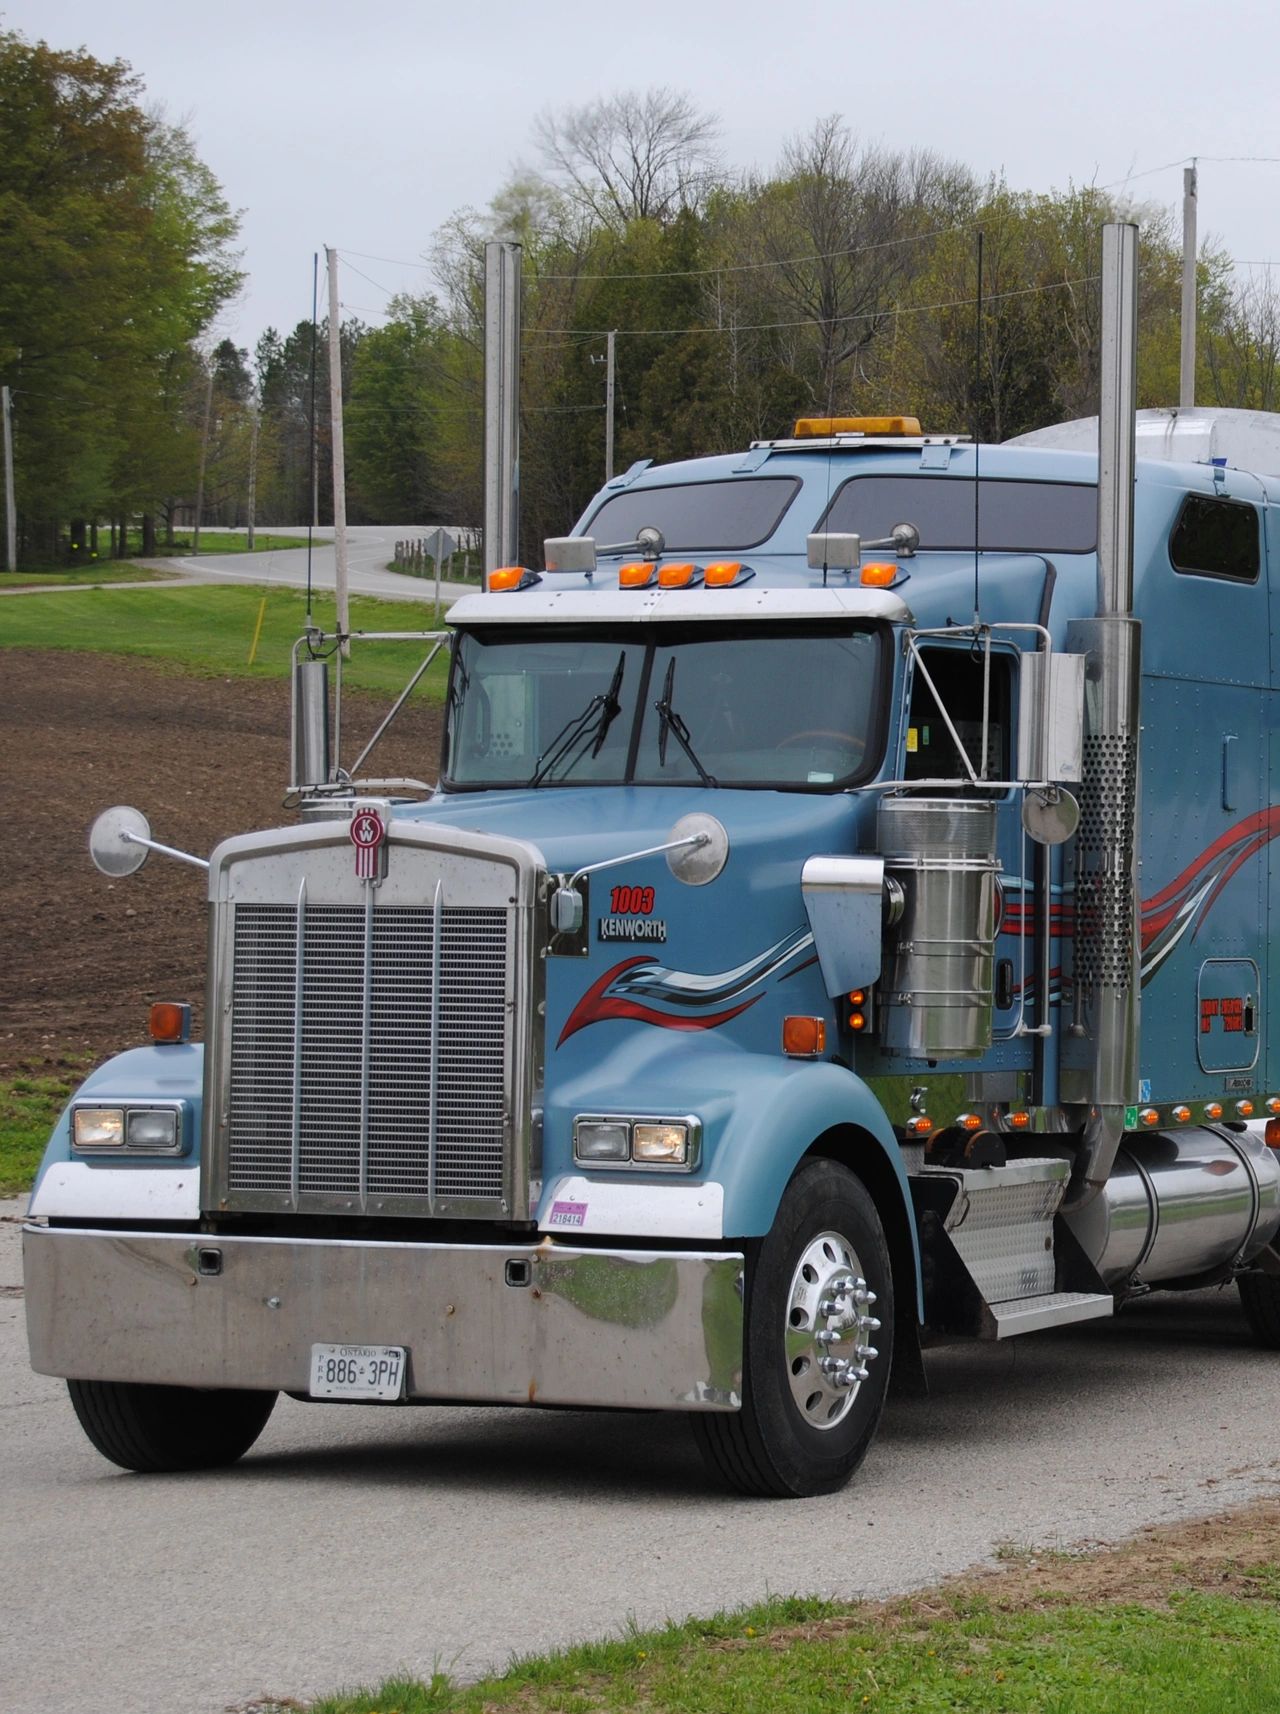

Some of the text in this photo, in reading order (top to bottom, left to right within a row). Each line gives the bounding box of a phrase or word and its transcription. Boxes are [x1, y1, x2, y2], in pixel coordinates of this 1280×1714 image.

[611, 886, 655, 915] 1003
[601, 918, 667, 938] KENWORTH
[326, 1358, 400, 1386] 886 3PH
